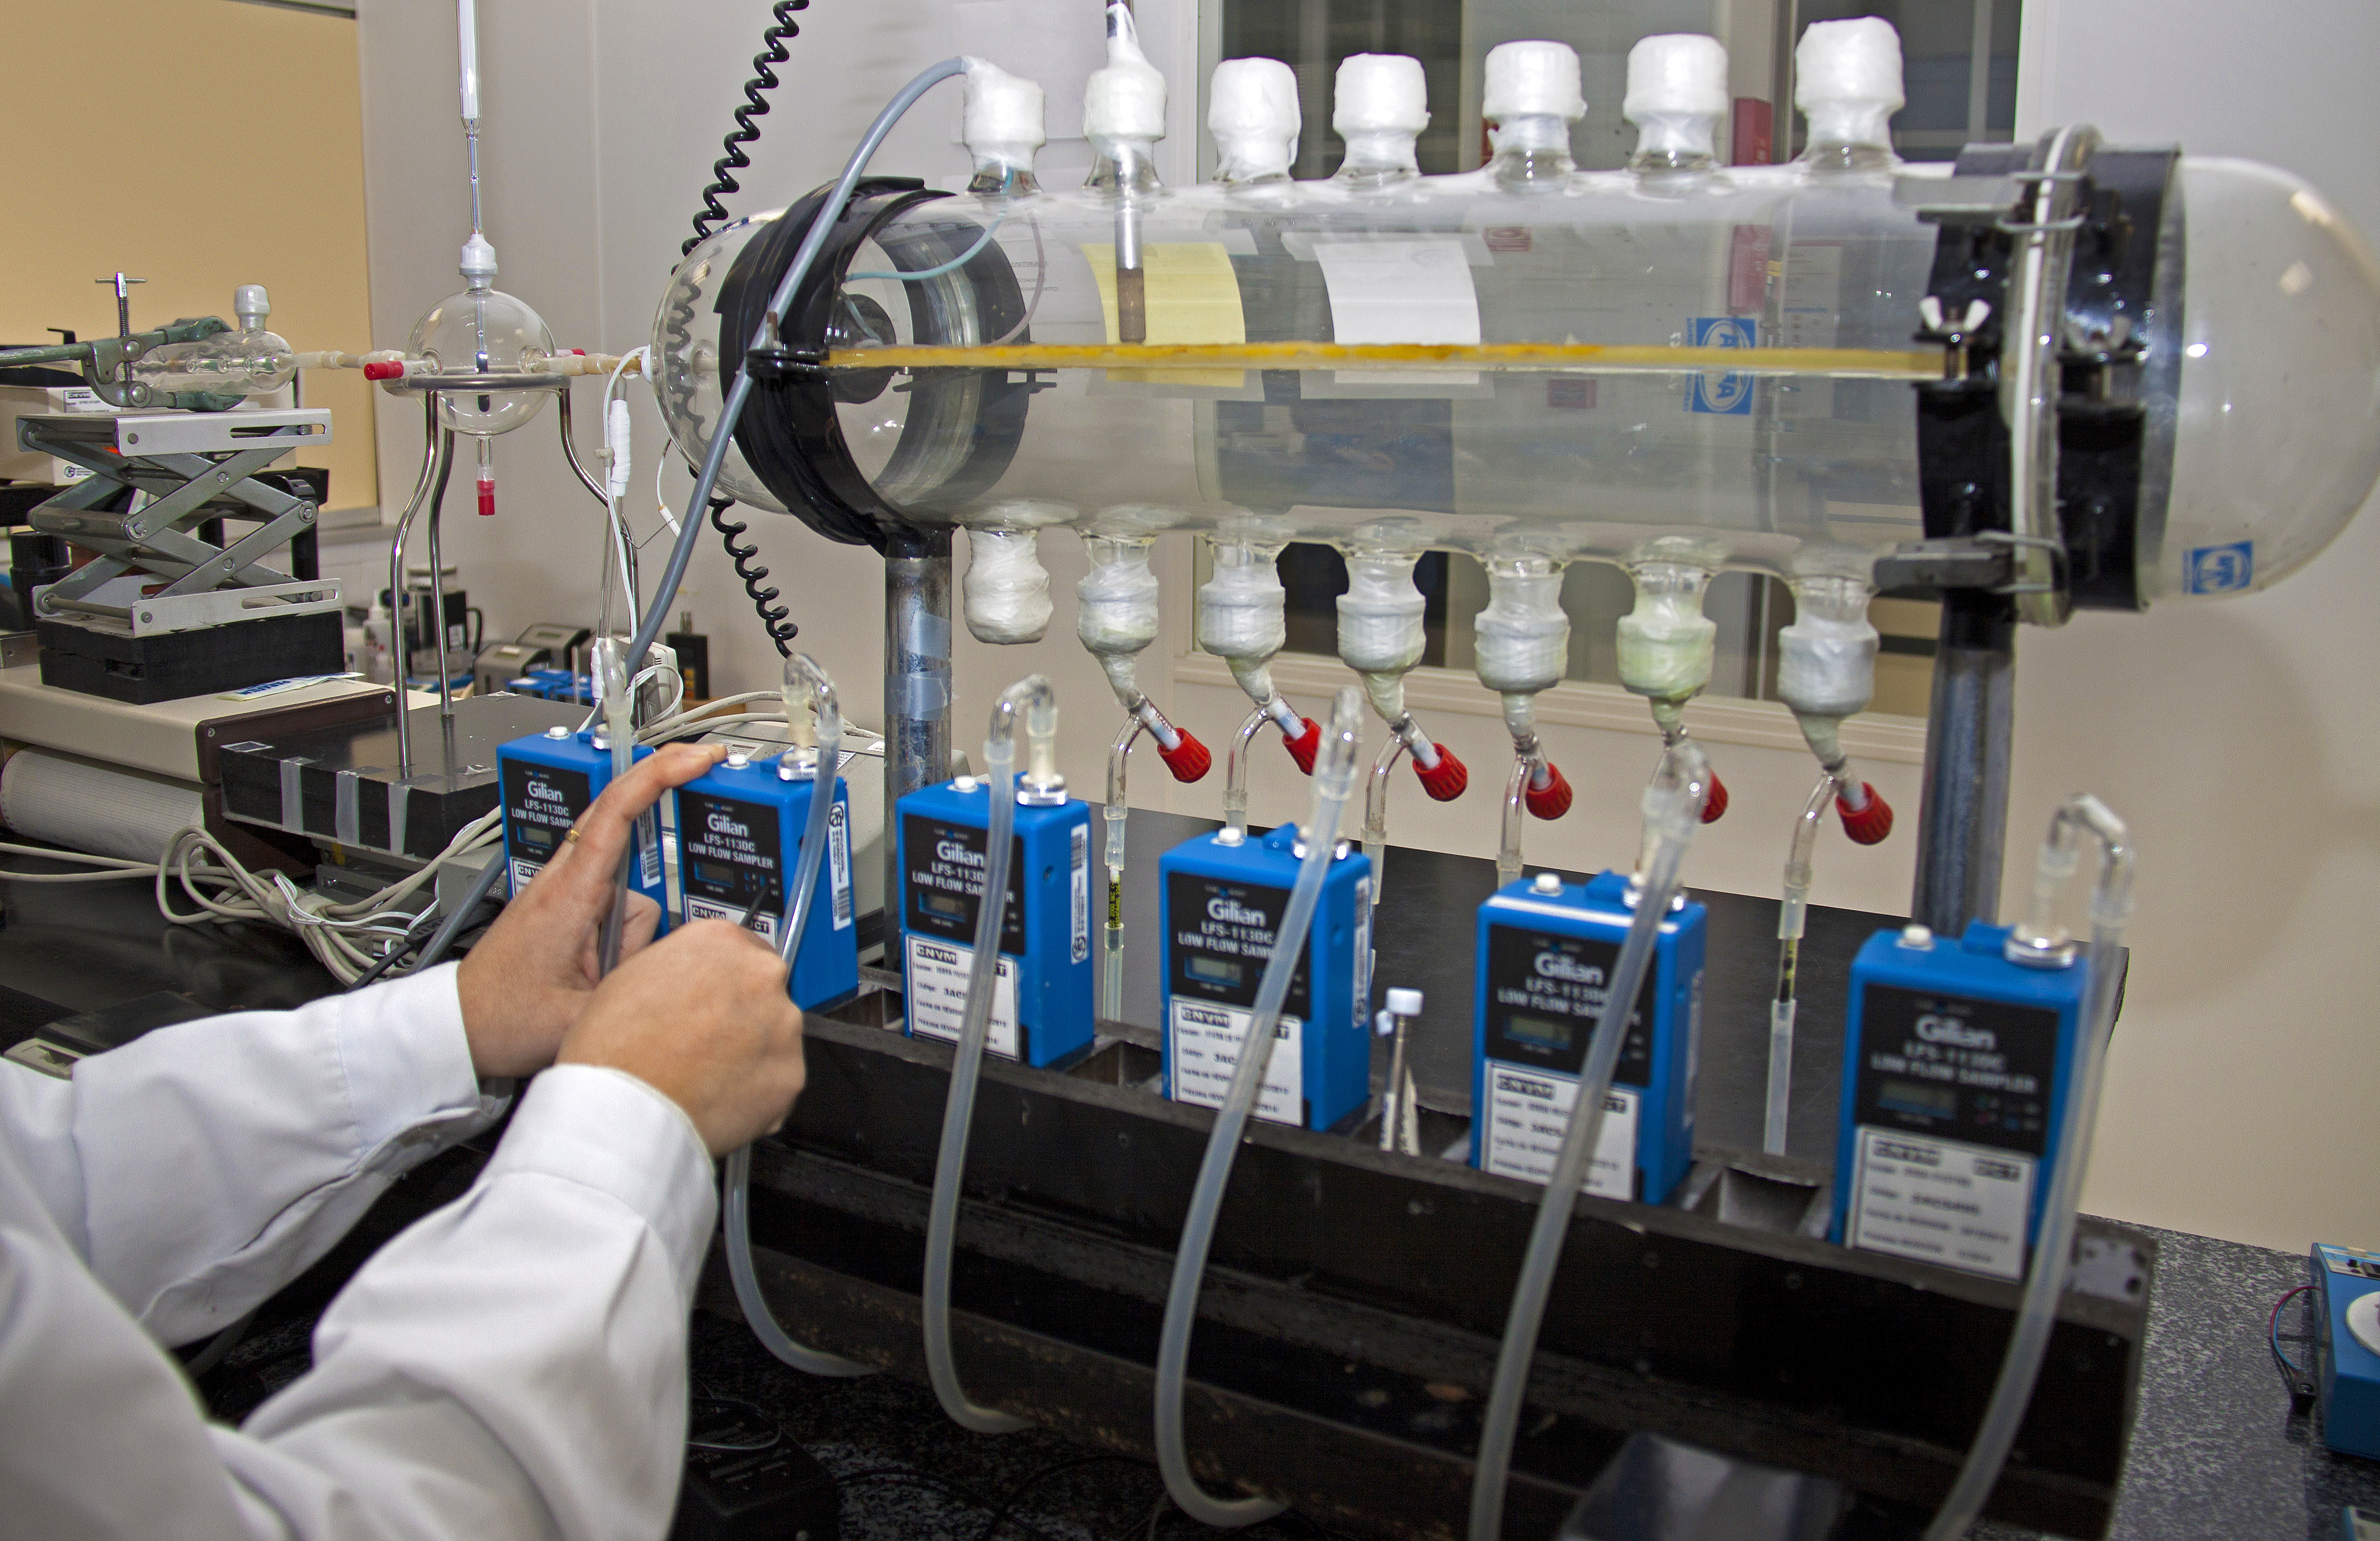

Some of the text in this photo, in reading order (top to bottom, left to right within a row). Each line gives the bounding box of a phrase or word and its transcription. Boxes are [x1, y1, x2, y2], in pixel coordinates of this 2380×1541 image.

[527, 780, 563, 802] Gilian
[511, 807, 527, 820] LOW
[529, 812, 548, 824] FLOW
[525, 799, 569, 816] LFS-113DC
[707, 812, 748, 837] Gilian
[703, 832, 755, 852] LFS-113DC
[936, 840, 985, 868] Gilian
[688, 841, 774, 869] LOW FLOW SAMPLER
[912, 870, 934, 886] LOW
[935, 875, 963, 893] FLOW
[1206, 897, 1267, 928] Gilian
[1178, 931, 1205, 949] LOW
[1205, 936, 1240, 955] FLOW
[1533, 950, 1605, 986] Gilian
[1530, 993, 1571, 1014] FLOW
[1915, 1014, 1996, 1050] Gilian
